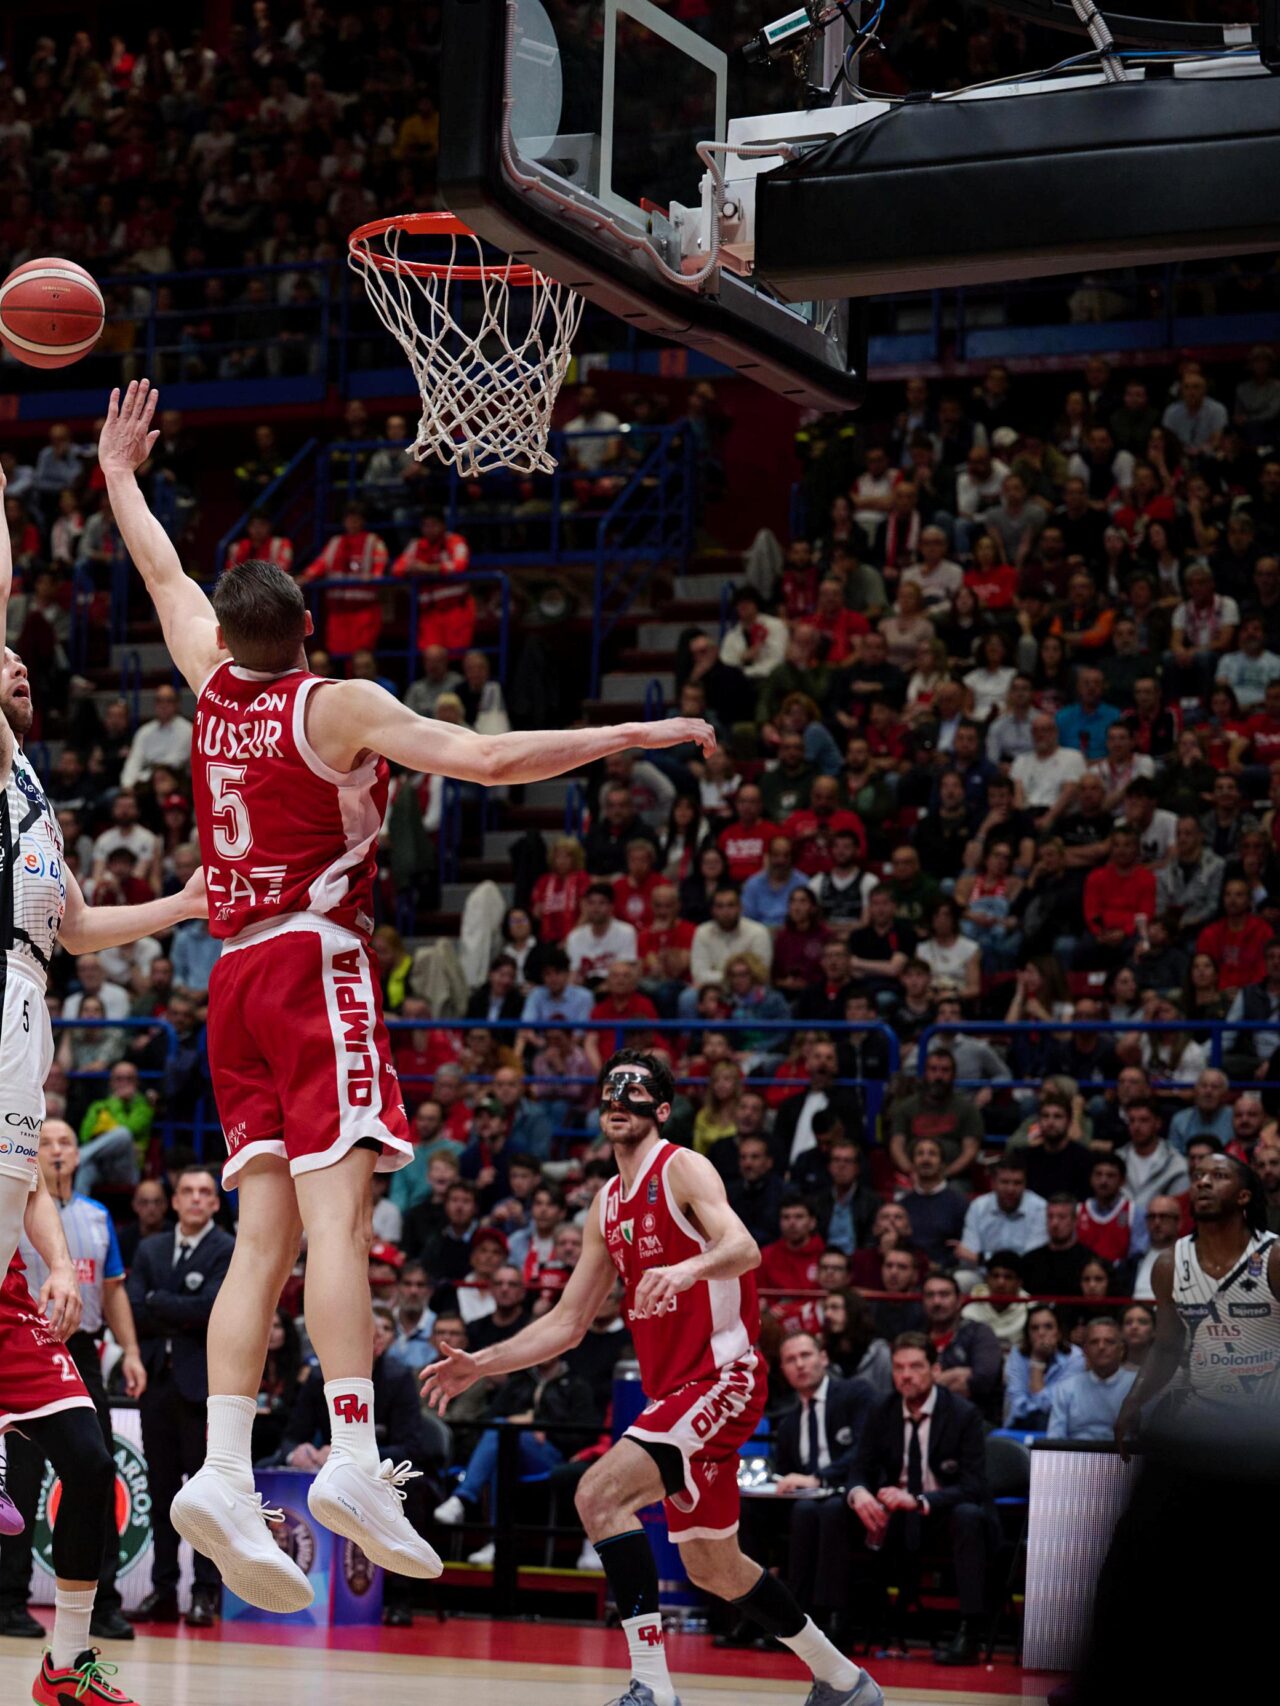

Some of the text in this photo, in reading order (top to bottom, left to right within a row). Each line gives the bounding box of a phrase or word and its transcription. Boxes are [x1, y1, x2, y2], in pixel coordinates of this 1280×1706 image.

[197, 711, 284, 759] USEUR
[206, 761, 253, 861] 5
[23, 1000, 29, 1032] 5
[332, 948, 374, 1107] OLIMPIA
[5, 1112, 43, 1131] CAVI
[15, 1145, 38, 1156] Dolo
[1183, 1260, 1190, 1281] 3
[1206, 1324, 1241, 1337] ITAS
[1211, 1350, 1274, 1366] Dolomiti
[113, 1449, 152, 1529] ARROS
